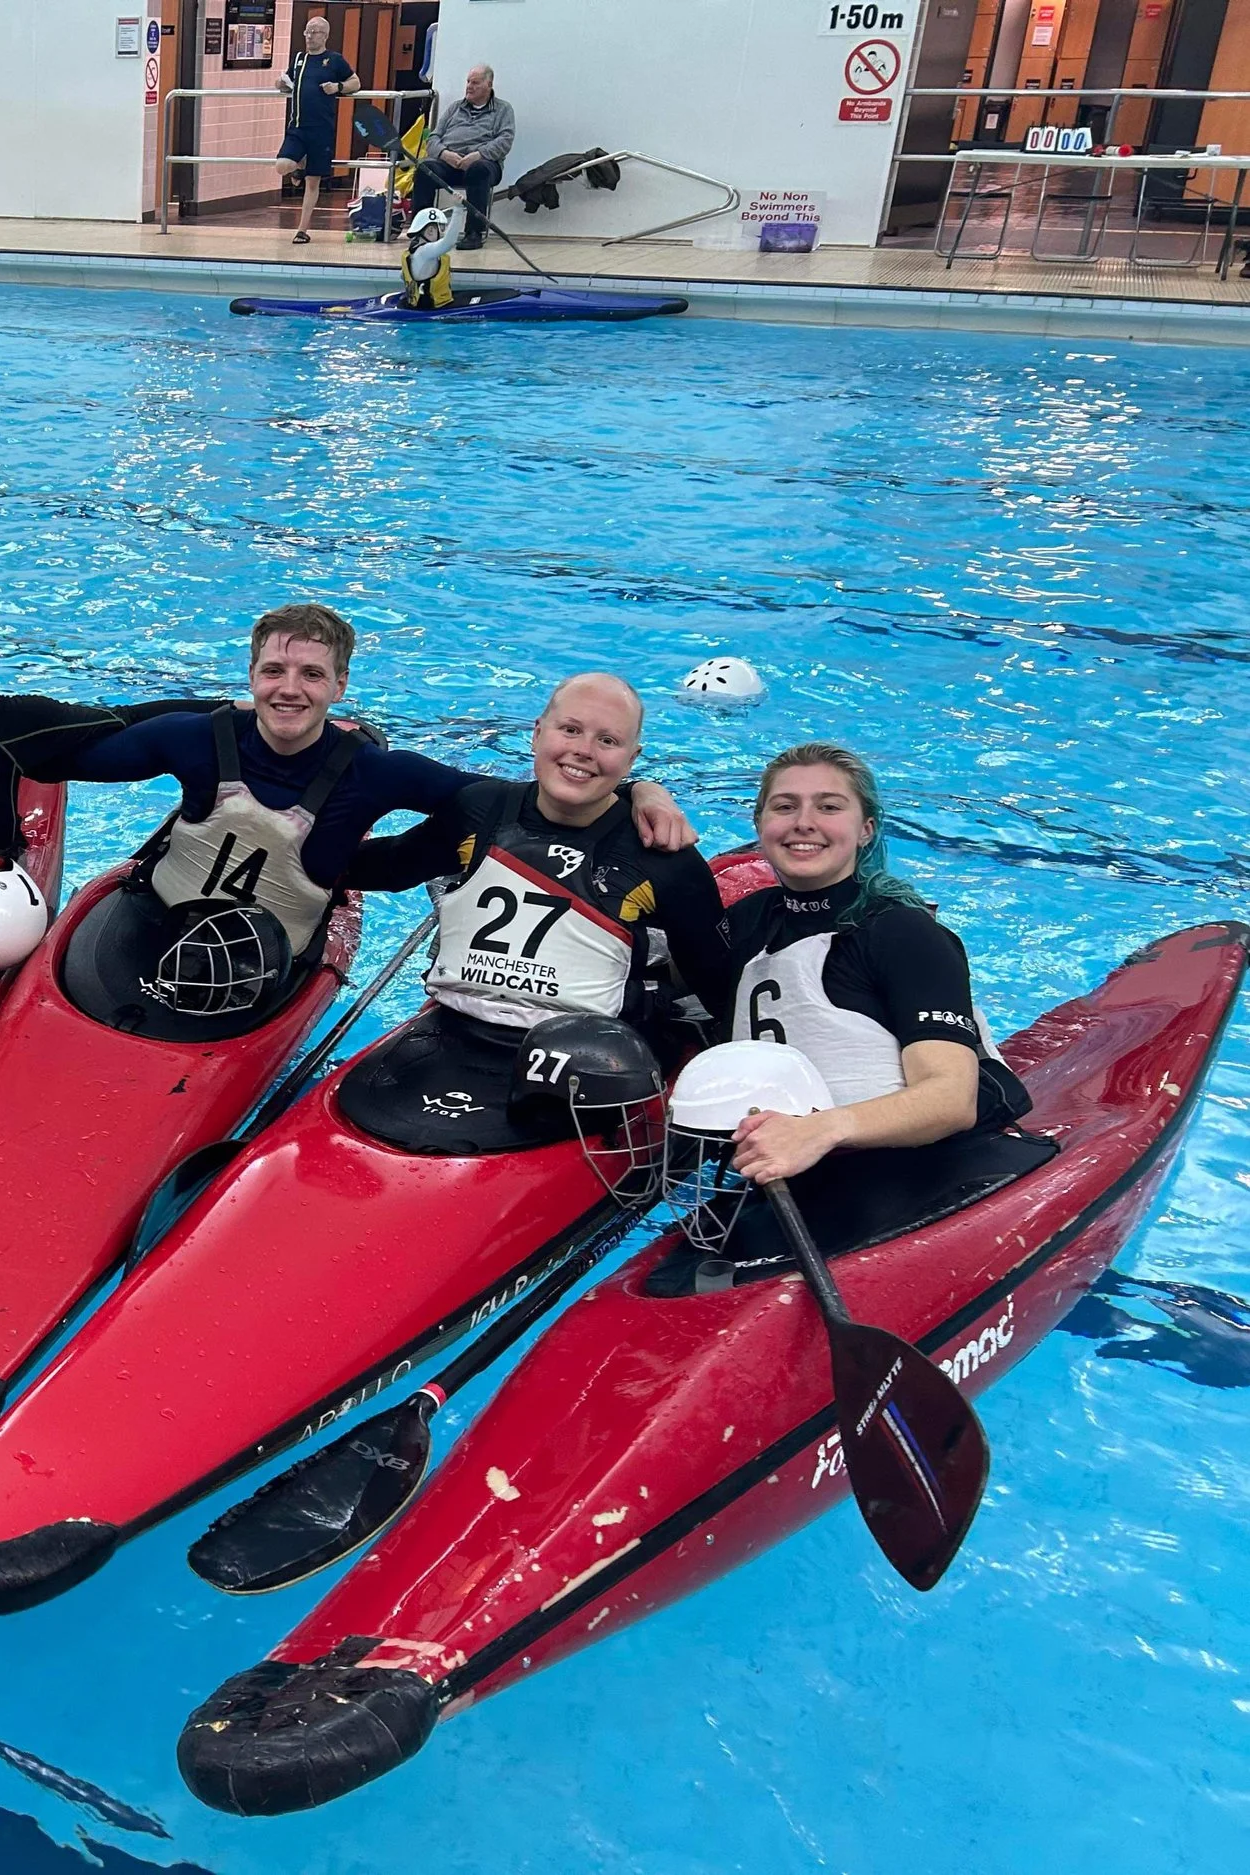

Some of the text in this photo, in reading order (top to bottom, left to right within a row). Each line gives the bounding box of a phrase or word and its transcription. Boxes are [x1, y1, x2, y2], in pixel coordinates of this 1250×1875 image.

[880, 13, 904, 29] m
[749, 201, 816, 212] Swimmers
[759, 191, 809, 201] No Non
[428, 209, 437, 221] 8
[741, 211, 821, 222] Beyond This
[200, 831, 269, 904] 14
[468, 885, 573, 960] 27
[466, 952, 557, 980] MANCHESTER
[460, 966, 560, 998] WILDCATS
[749, 978, 787, 1045] 6
[526, 1048, 572, 1085] 27
